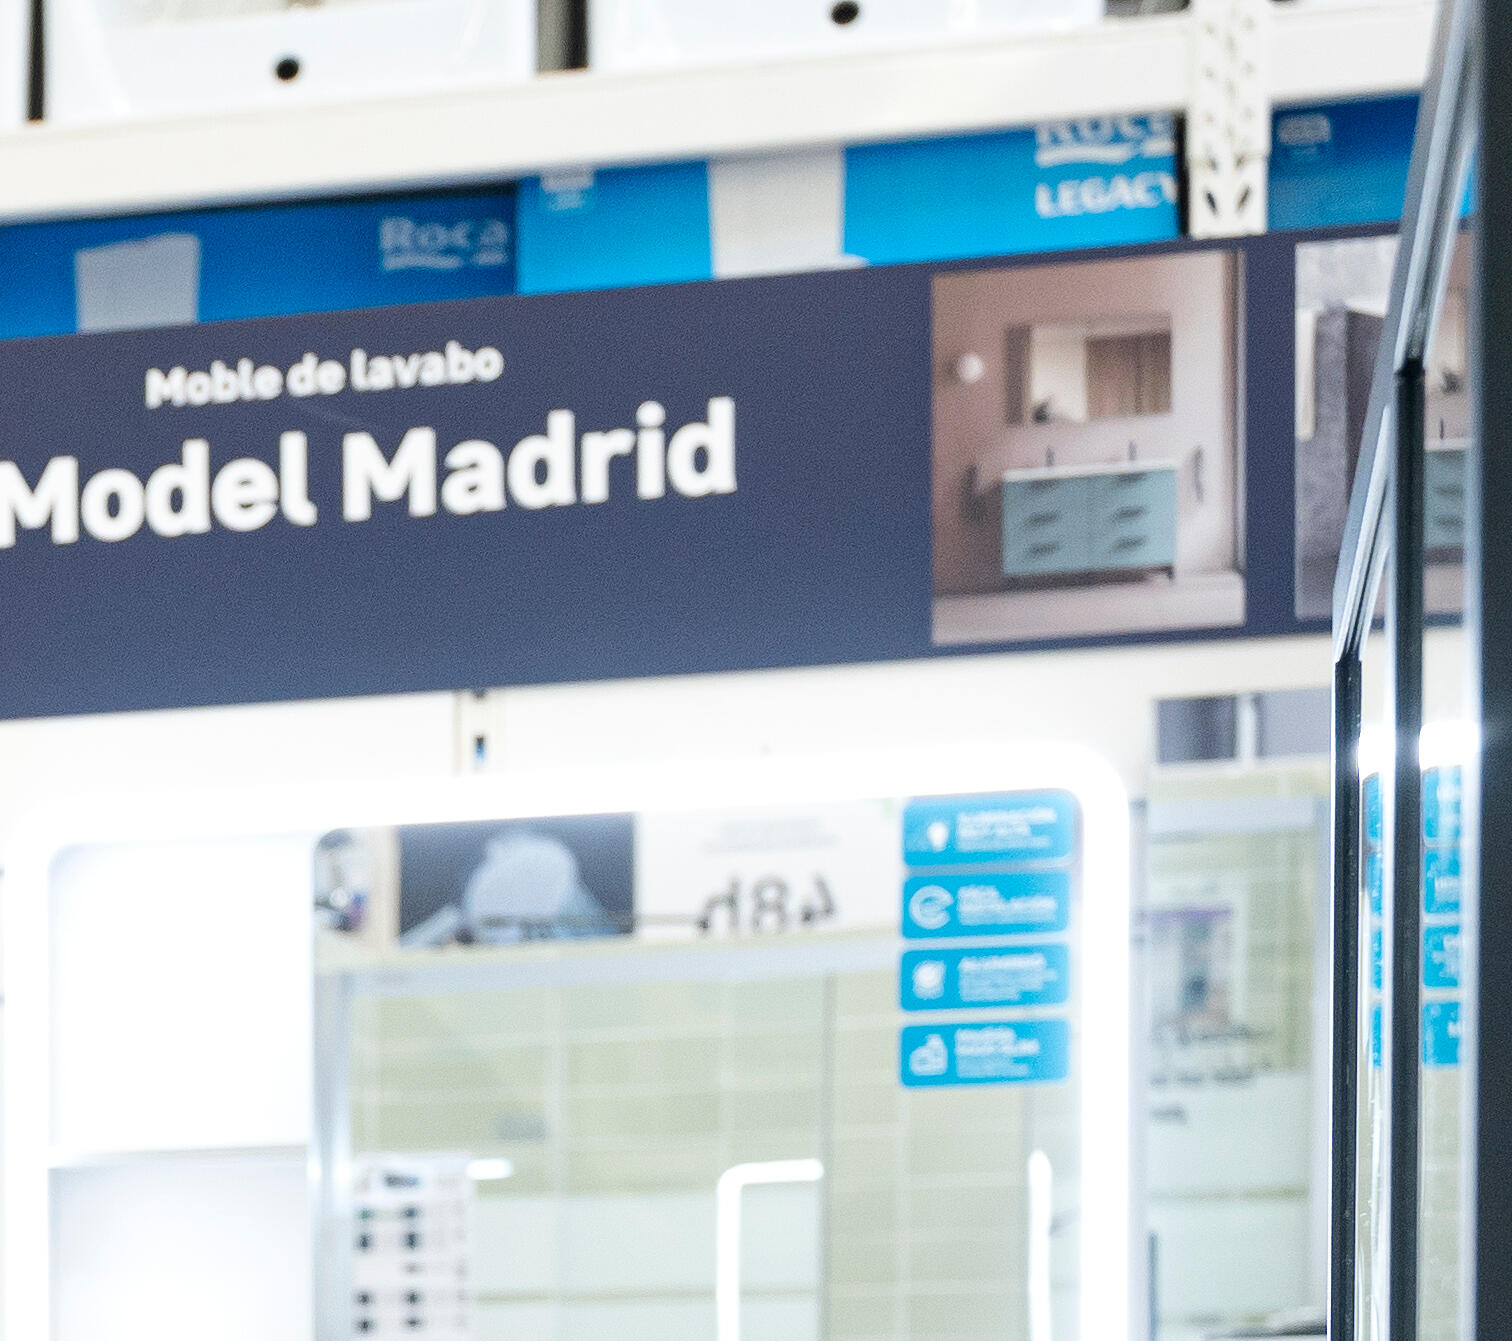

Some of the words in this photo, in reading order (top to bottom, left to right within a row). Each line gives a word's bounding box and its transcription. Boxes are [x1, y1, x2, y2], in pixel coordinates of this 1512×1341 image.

[380, 217, 508, 270] Roca
[145, 363, 281, 409] Moble
[288, 351, 344, 399] de
[353, 341, 504, 394] lavabo
[342, 397, 738, 522] Madrid
